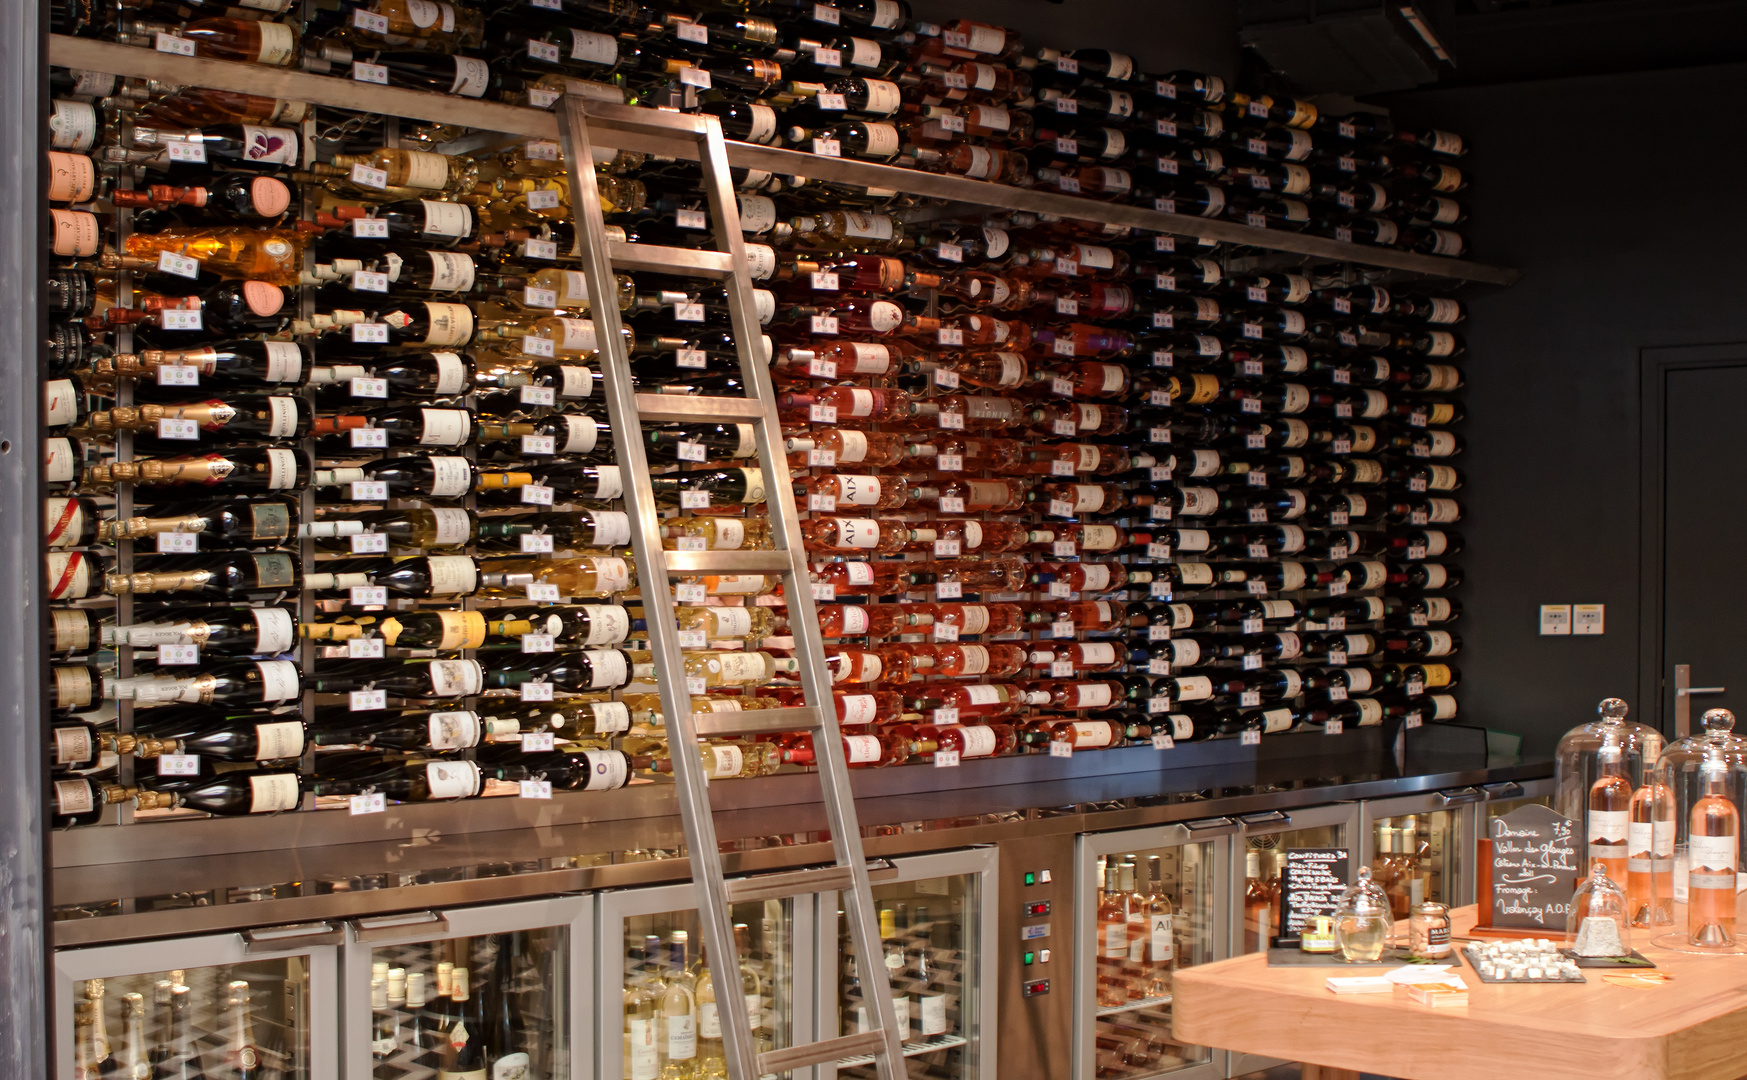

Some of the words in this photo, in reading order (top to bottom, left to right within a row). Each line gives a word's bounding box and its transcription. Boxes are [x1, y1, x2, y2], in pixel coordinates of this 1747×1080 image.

[844, 477, 856, 501] AIX
[843, 520, 854, 544] AIX
[1494, 819, 1540, 838] Domaine
